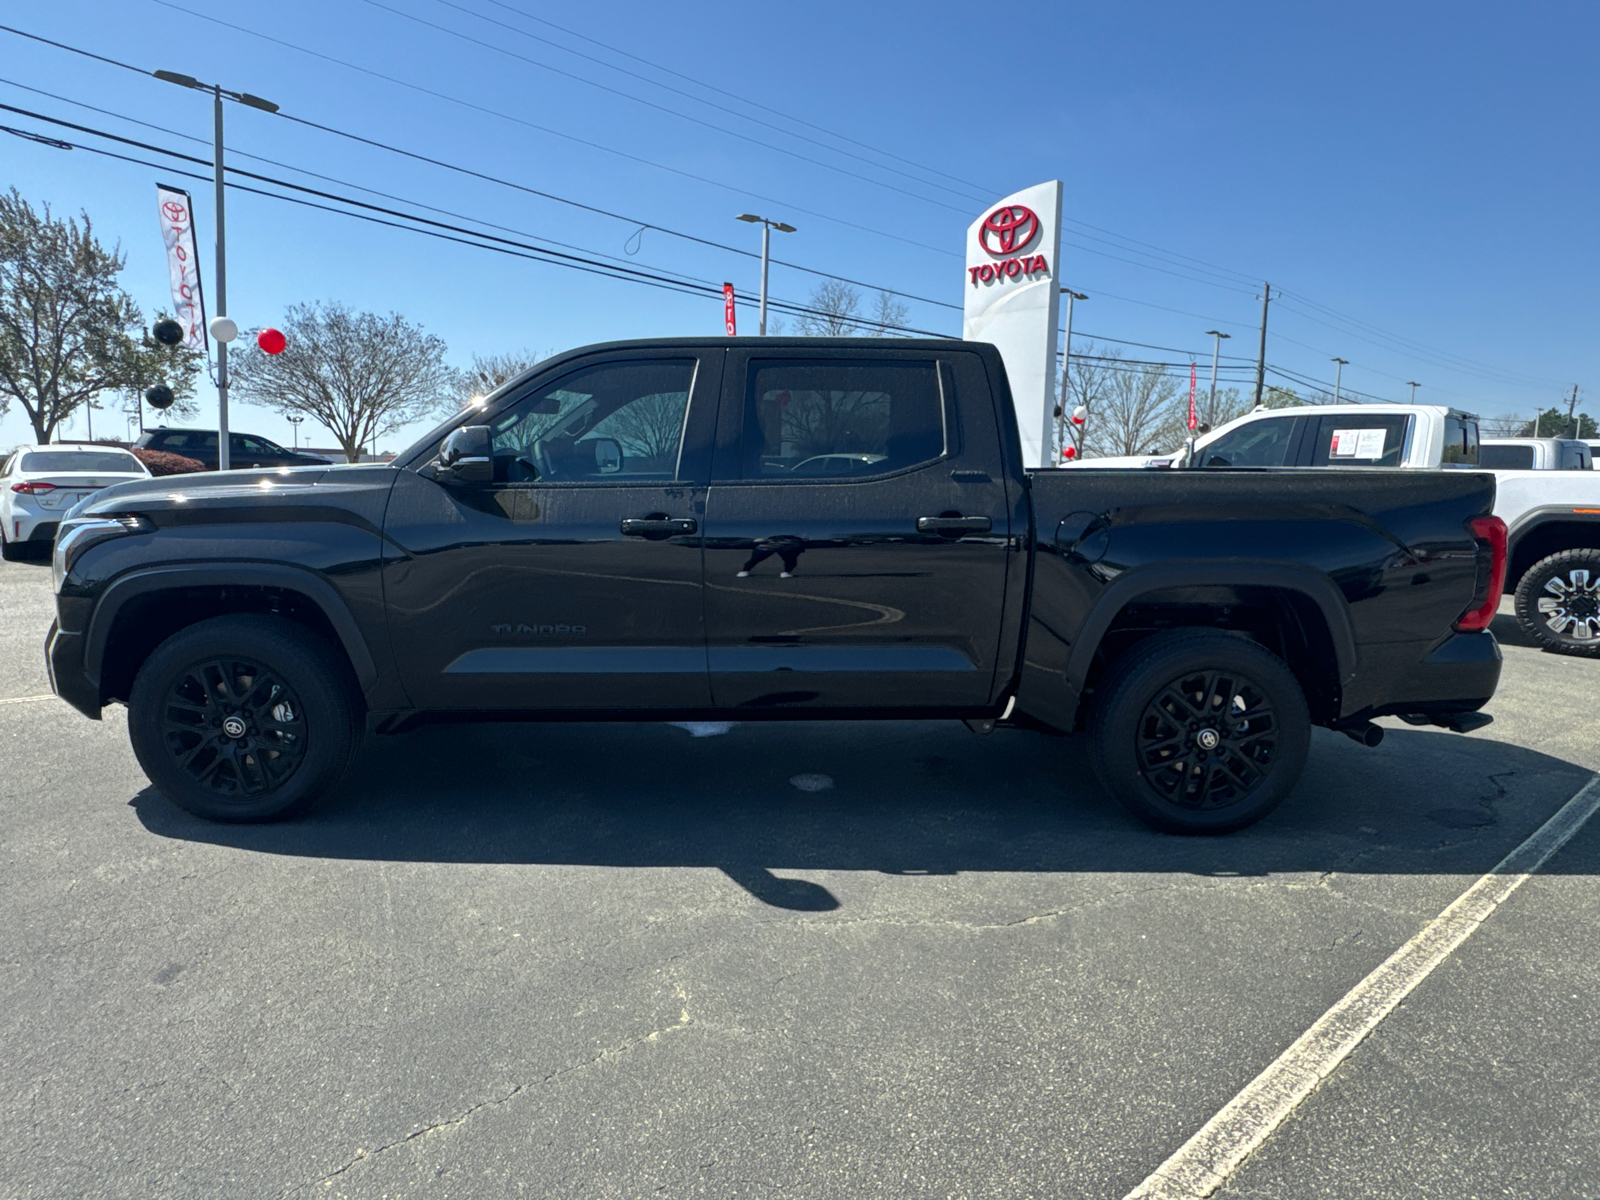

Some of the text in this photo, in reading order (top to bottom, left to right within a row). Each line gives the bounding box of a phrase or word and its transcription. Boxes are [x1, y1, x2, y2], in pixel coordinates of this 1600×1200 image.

[171, 226, 197, 339] TOYOTA
[968, 254, 1048, 285] TOYOTA
[489, 623, 588, 636] TUNDRA
